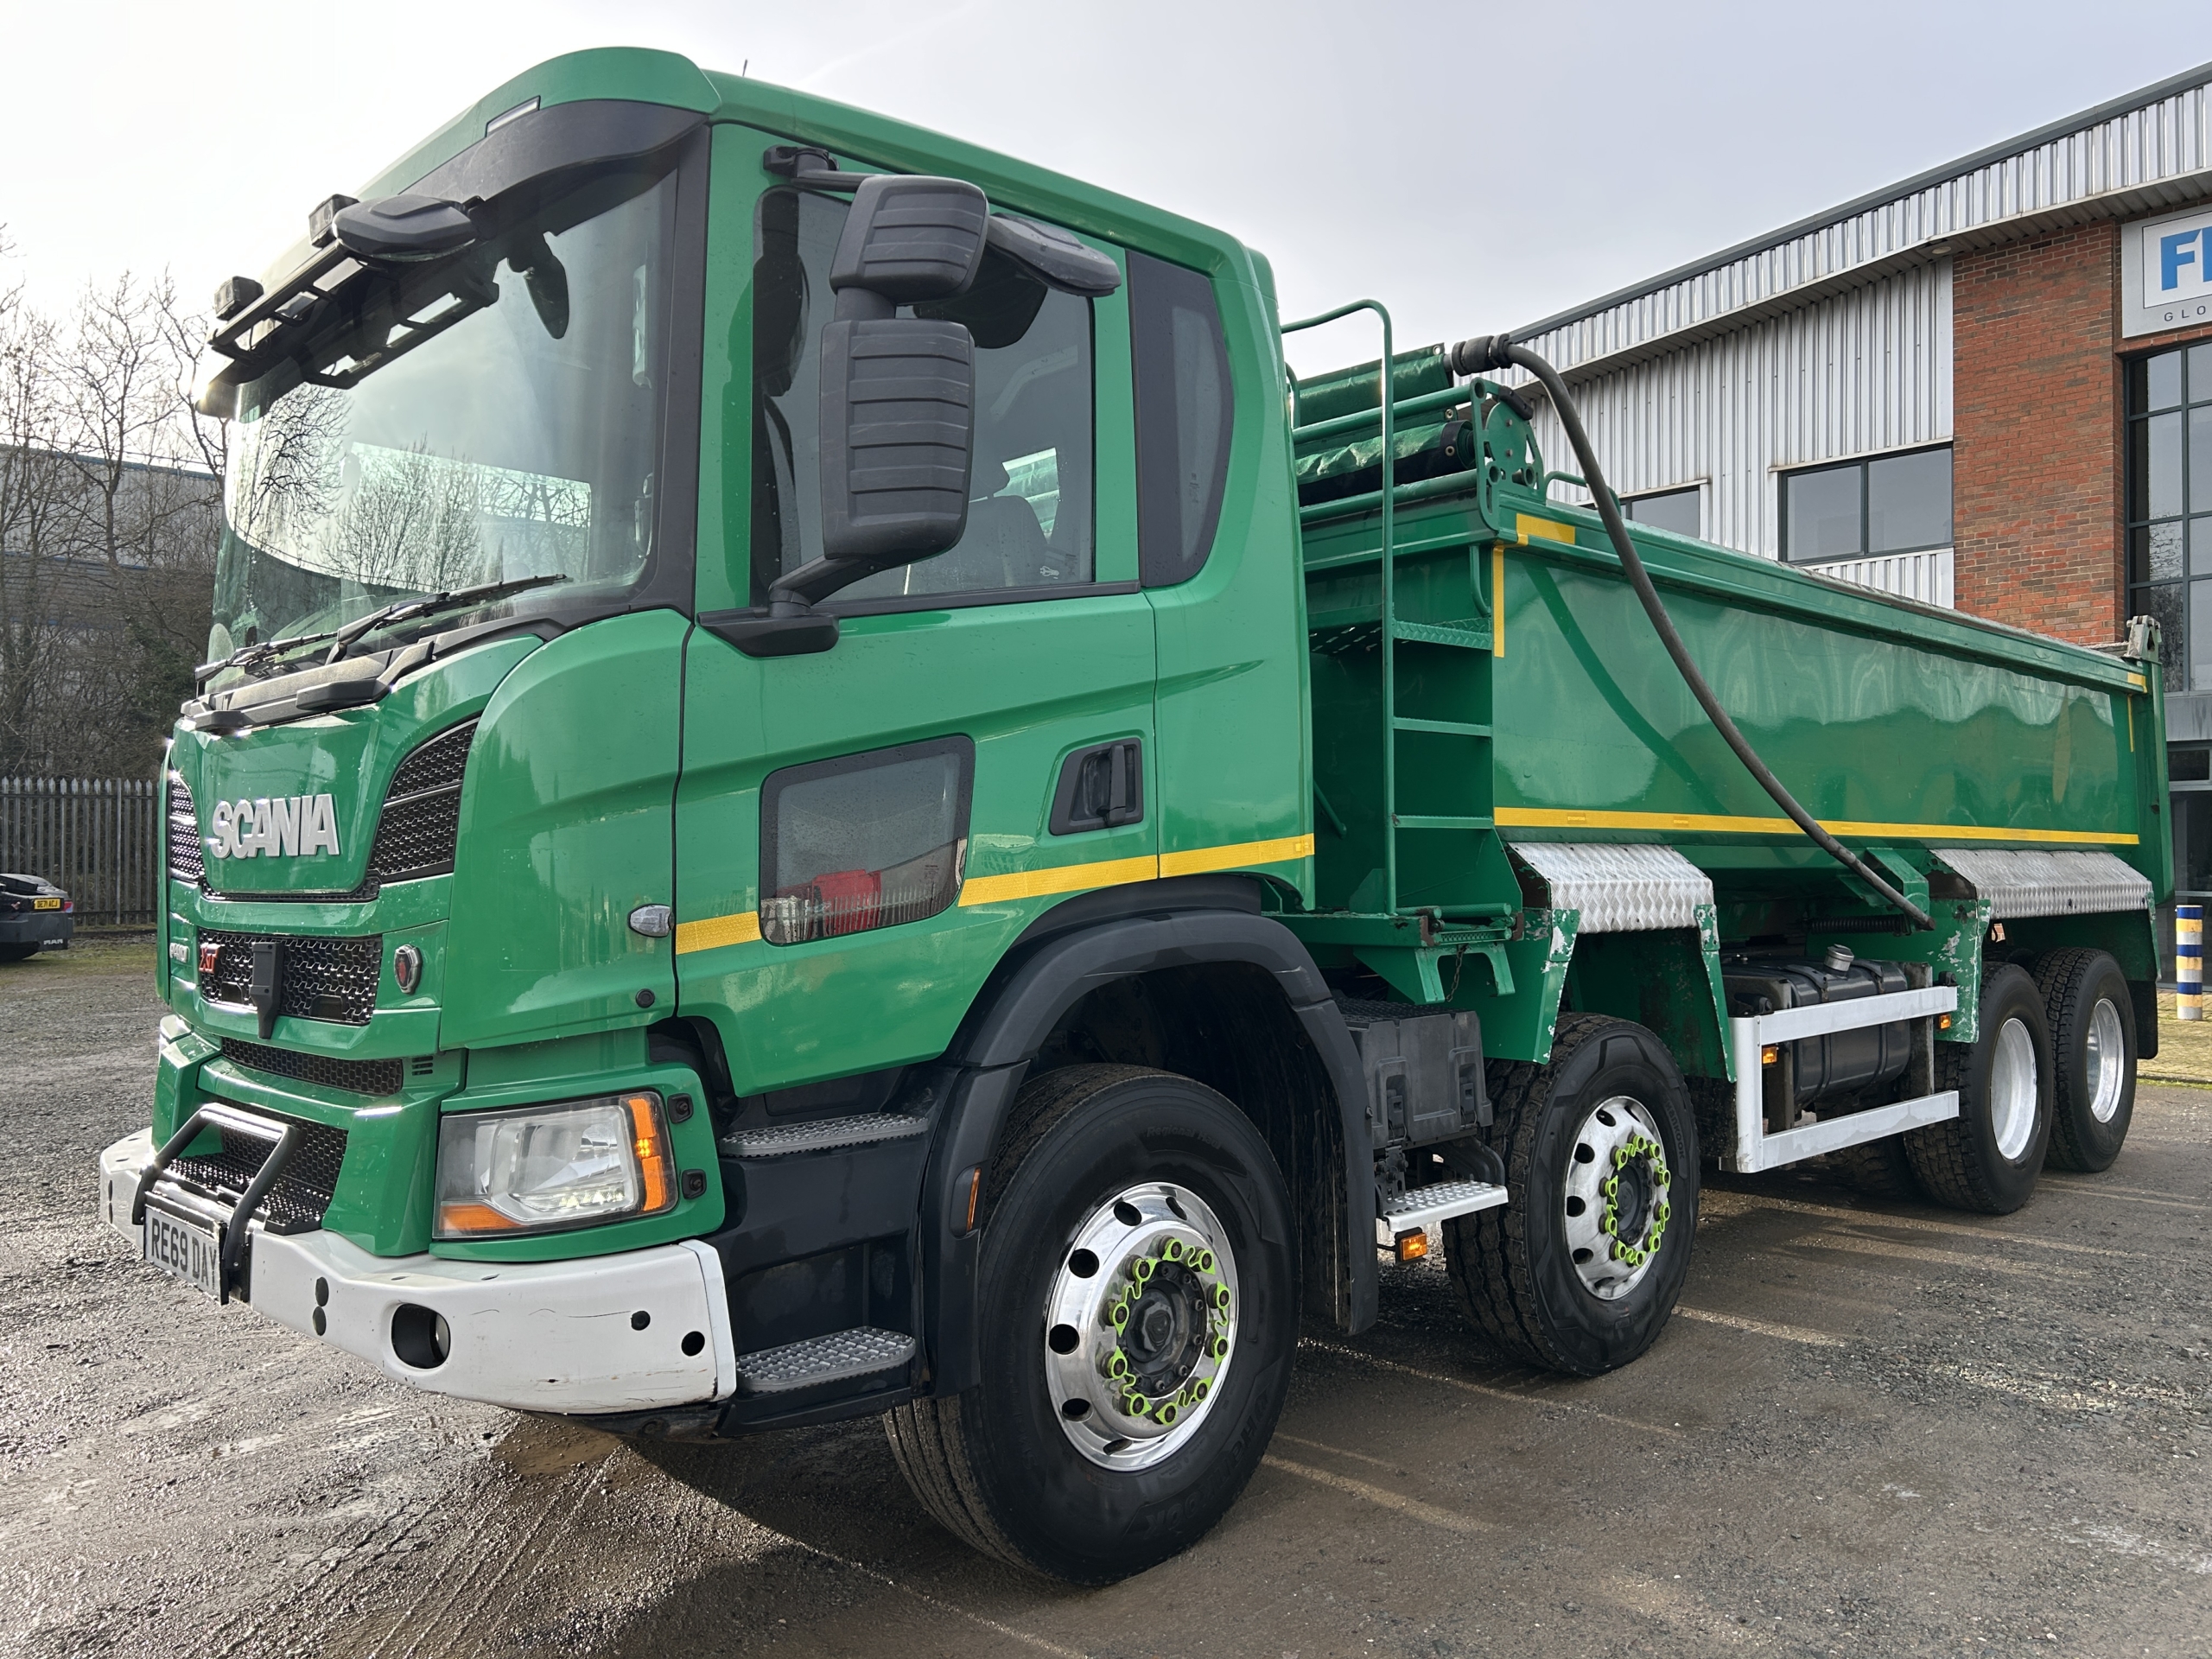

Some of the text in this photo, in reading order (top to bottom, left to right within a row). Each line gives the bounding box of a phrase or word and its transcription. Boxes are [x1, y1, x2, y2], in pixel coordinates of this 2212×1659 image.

[2160, 226, 2212, 291] F
[2164, 305, 2206, 322] GLO
[212, 793, 340, 859] SCANIA
[199, 943, 219, 974] XT
[1146, 1125, 1196, 1138] Regional
[151, 1217, 217, 1290] RE69 DAY
